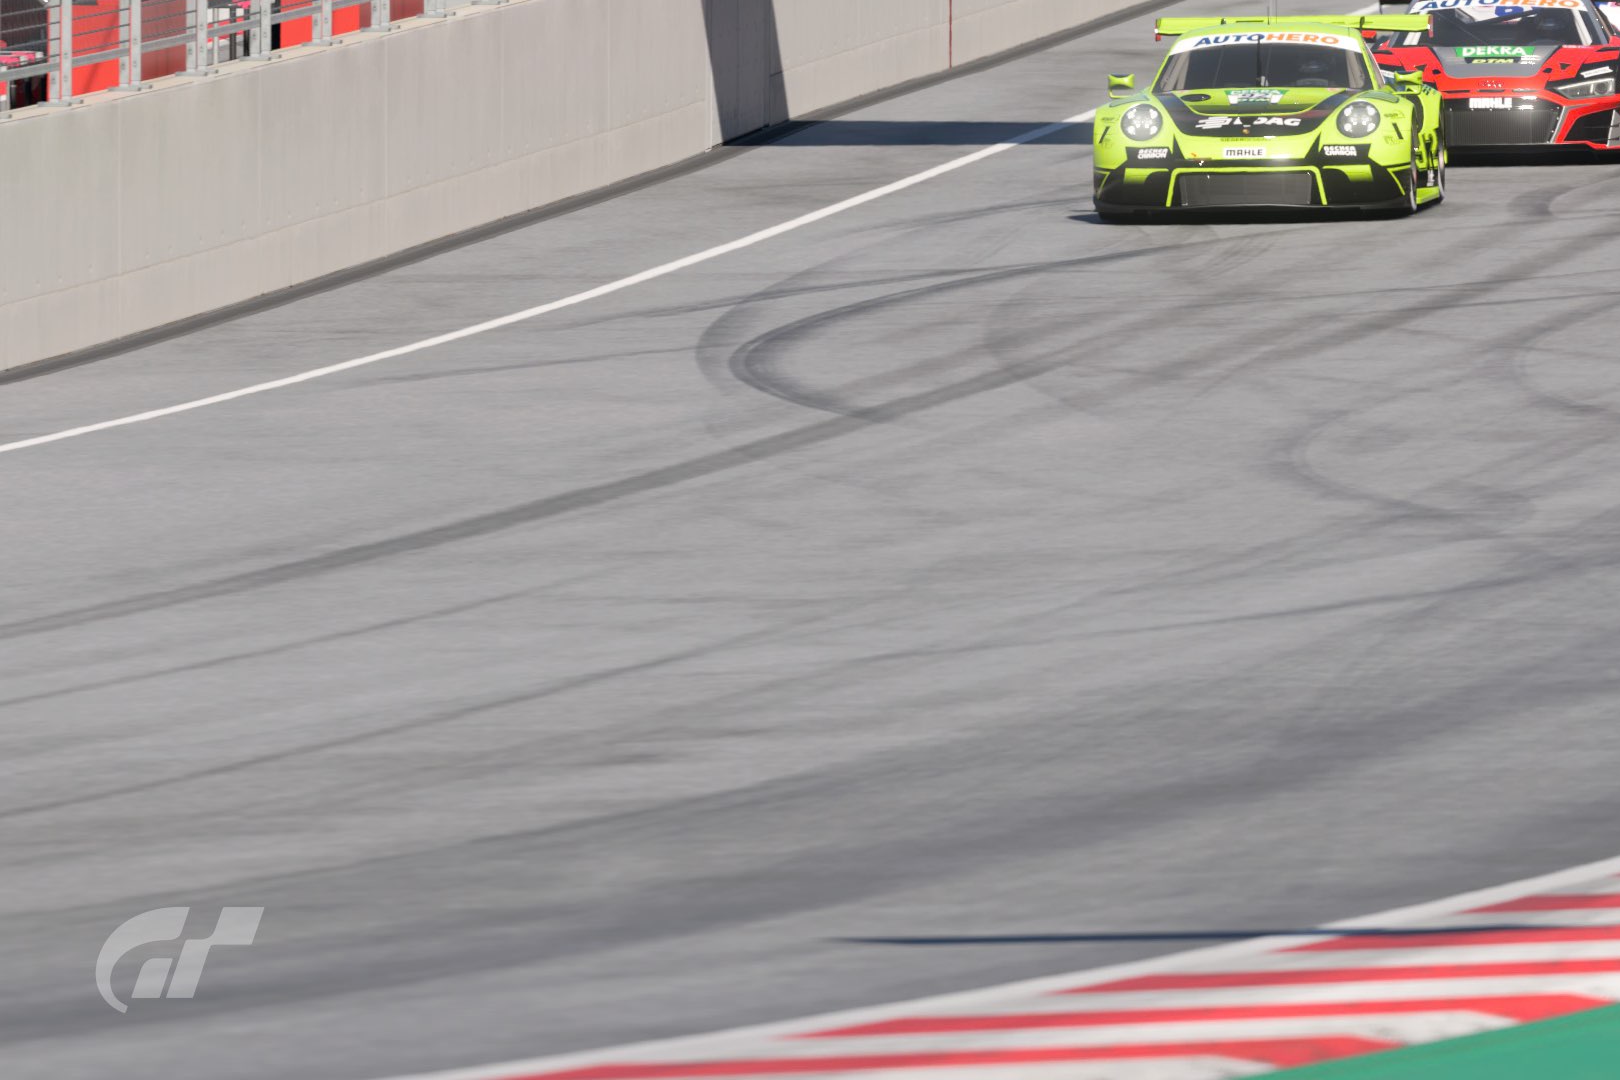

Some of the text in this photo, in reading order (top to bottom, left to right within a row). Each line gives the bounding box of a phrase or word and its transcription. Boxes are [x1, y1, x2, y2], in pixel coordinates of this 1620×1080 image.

[1193, 32, 1340, 48] AUTOHERO
[1462, 45, 1527, 57] DEKRA
[1225, 148, 1264, 156] MAHLE
